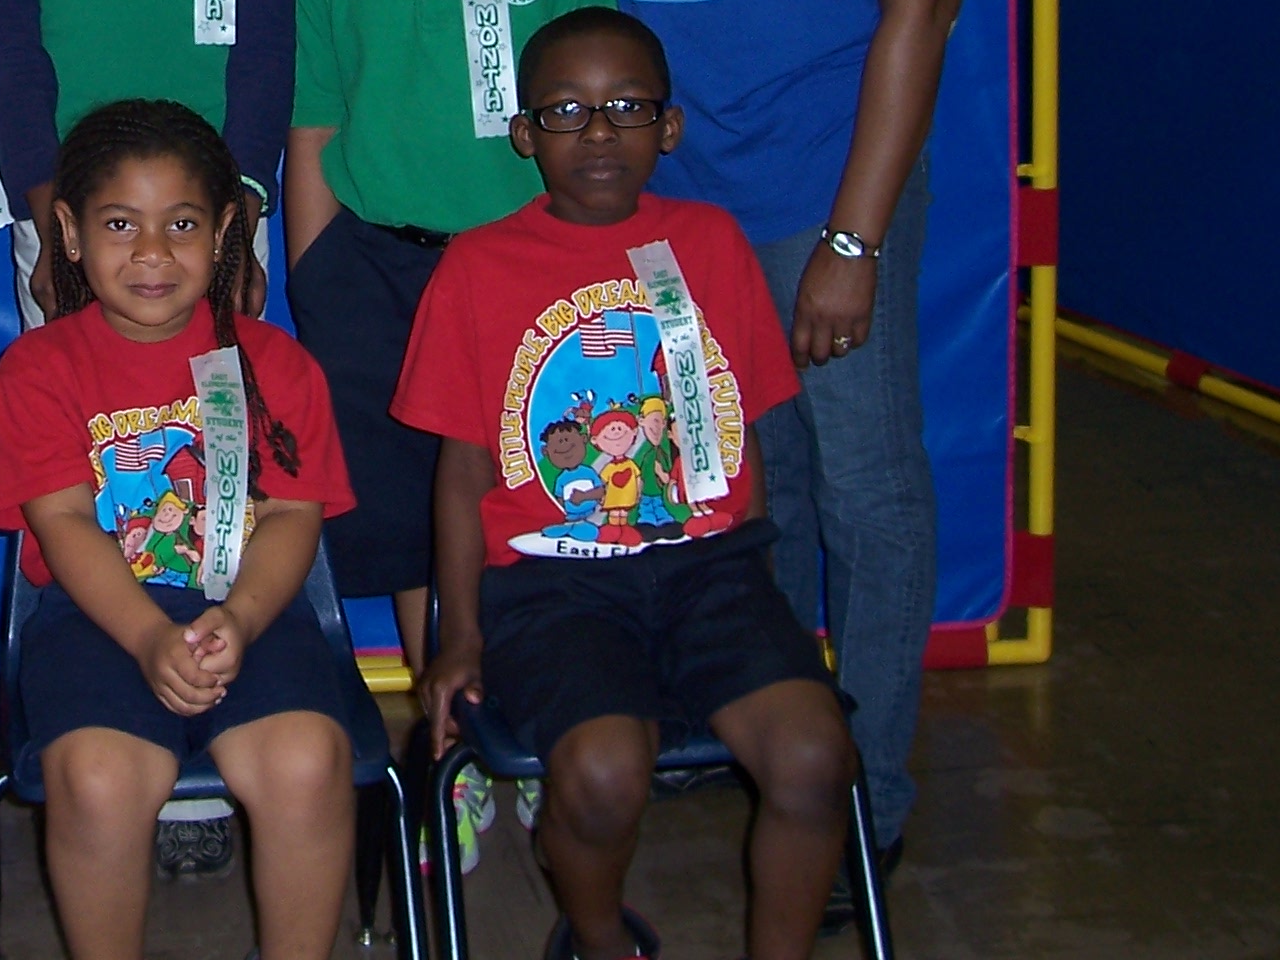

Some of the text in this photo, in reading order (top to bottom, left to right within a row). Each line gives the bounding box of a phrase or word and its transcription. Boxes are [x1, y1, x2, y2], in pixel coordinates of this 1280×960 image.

[475, 4, 504, 113] MONTH
[88, 414, 115, 443] IG
[501, 411, 534, 488] LITTLE
[538, 300, 577, 337] BIG
[573, 280, 651, 318] DREAM
[675, 350, 709, 474] MONTH
[212, 449, 239, 576] MONTH
[556, 540, 600, 558] East
